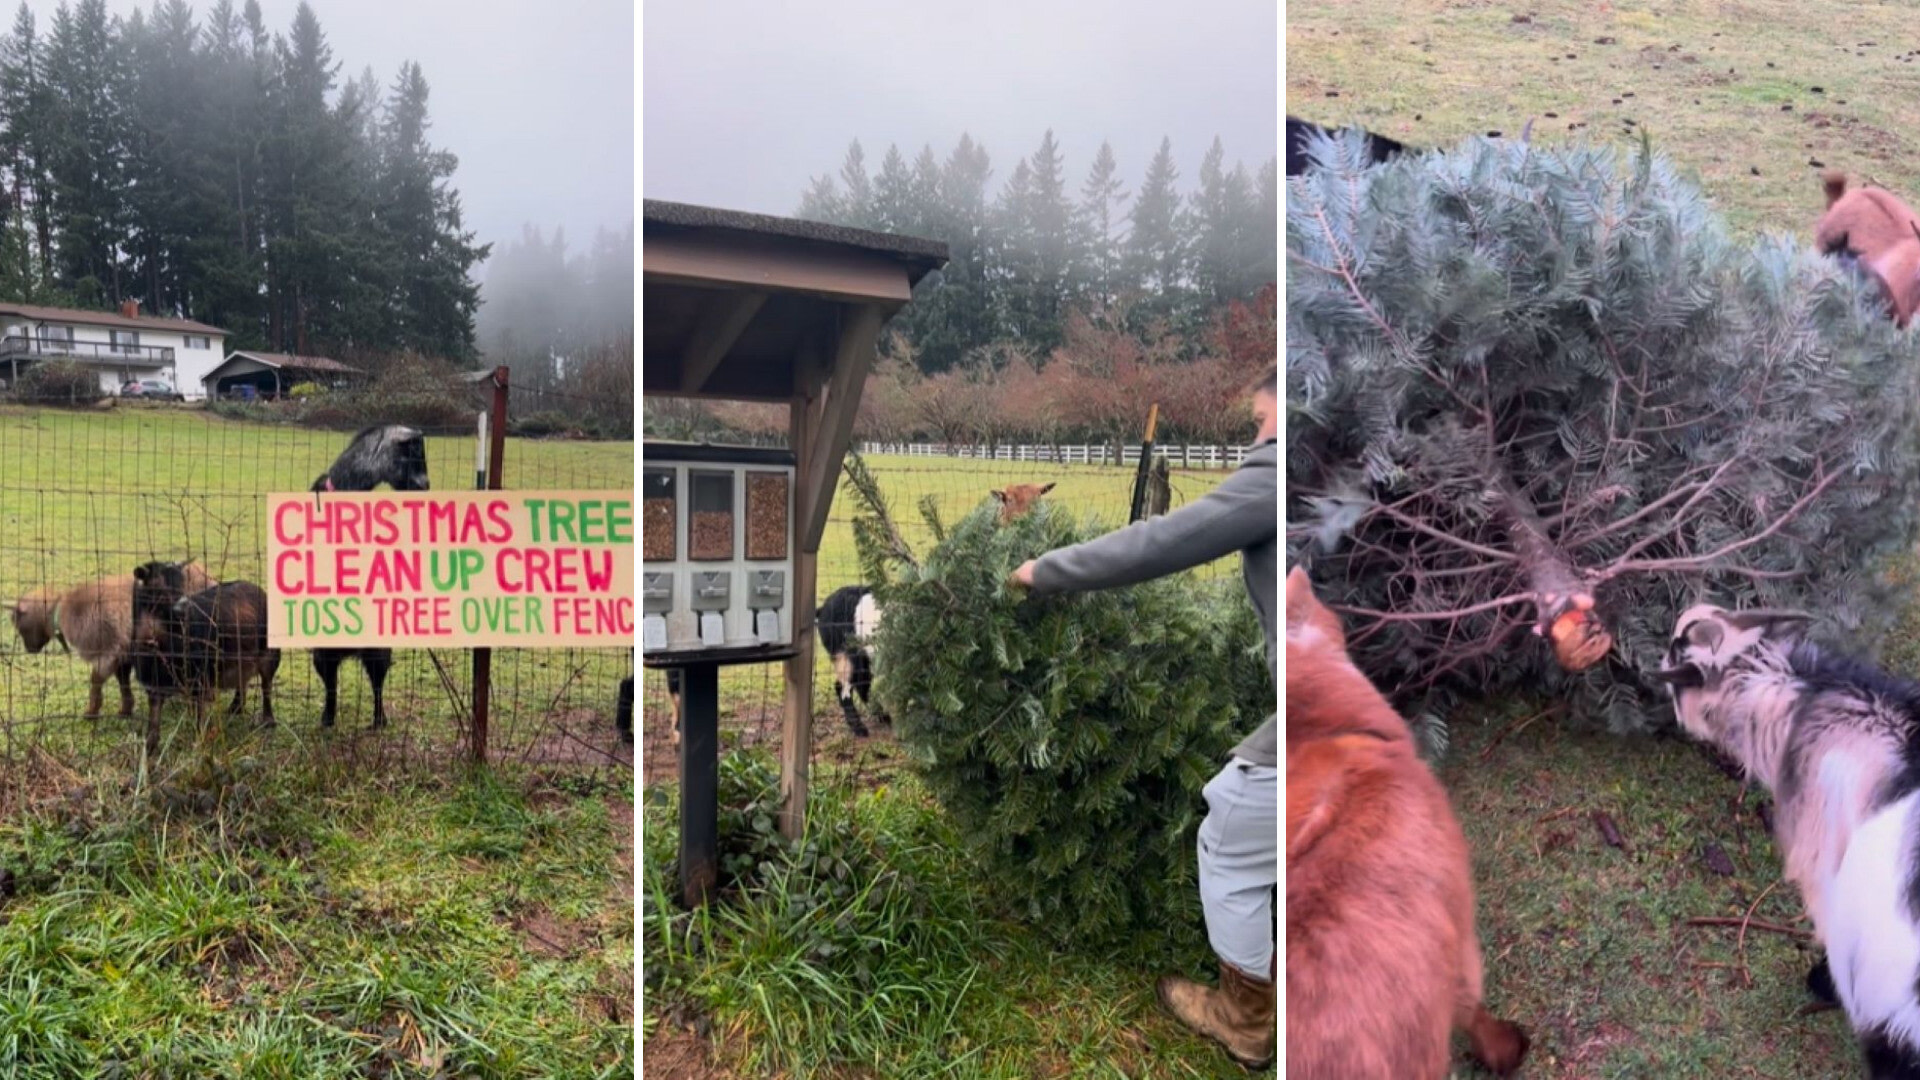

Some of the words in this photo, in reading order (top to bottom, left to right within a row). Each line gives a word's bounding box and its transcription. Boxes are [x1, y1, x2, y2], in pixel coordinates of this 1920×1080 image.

[274, 500, 513, 546] CHRISTMAS
[523, 499, 633, 543] TREE
[275, 549, 422, 595] CLEAN
[430, 550, 485, 592] UP
[495, 548, 613, 594] CREW
[283, 597, 363, 636] TOSS
[373, 597, 452, 635] TREE
[461, 596, 544, 634] OVER
